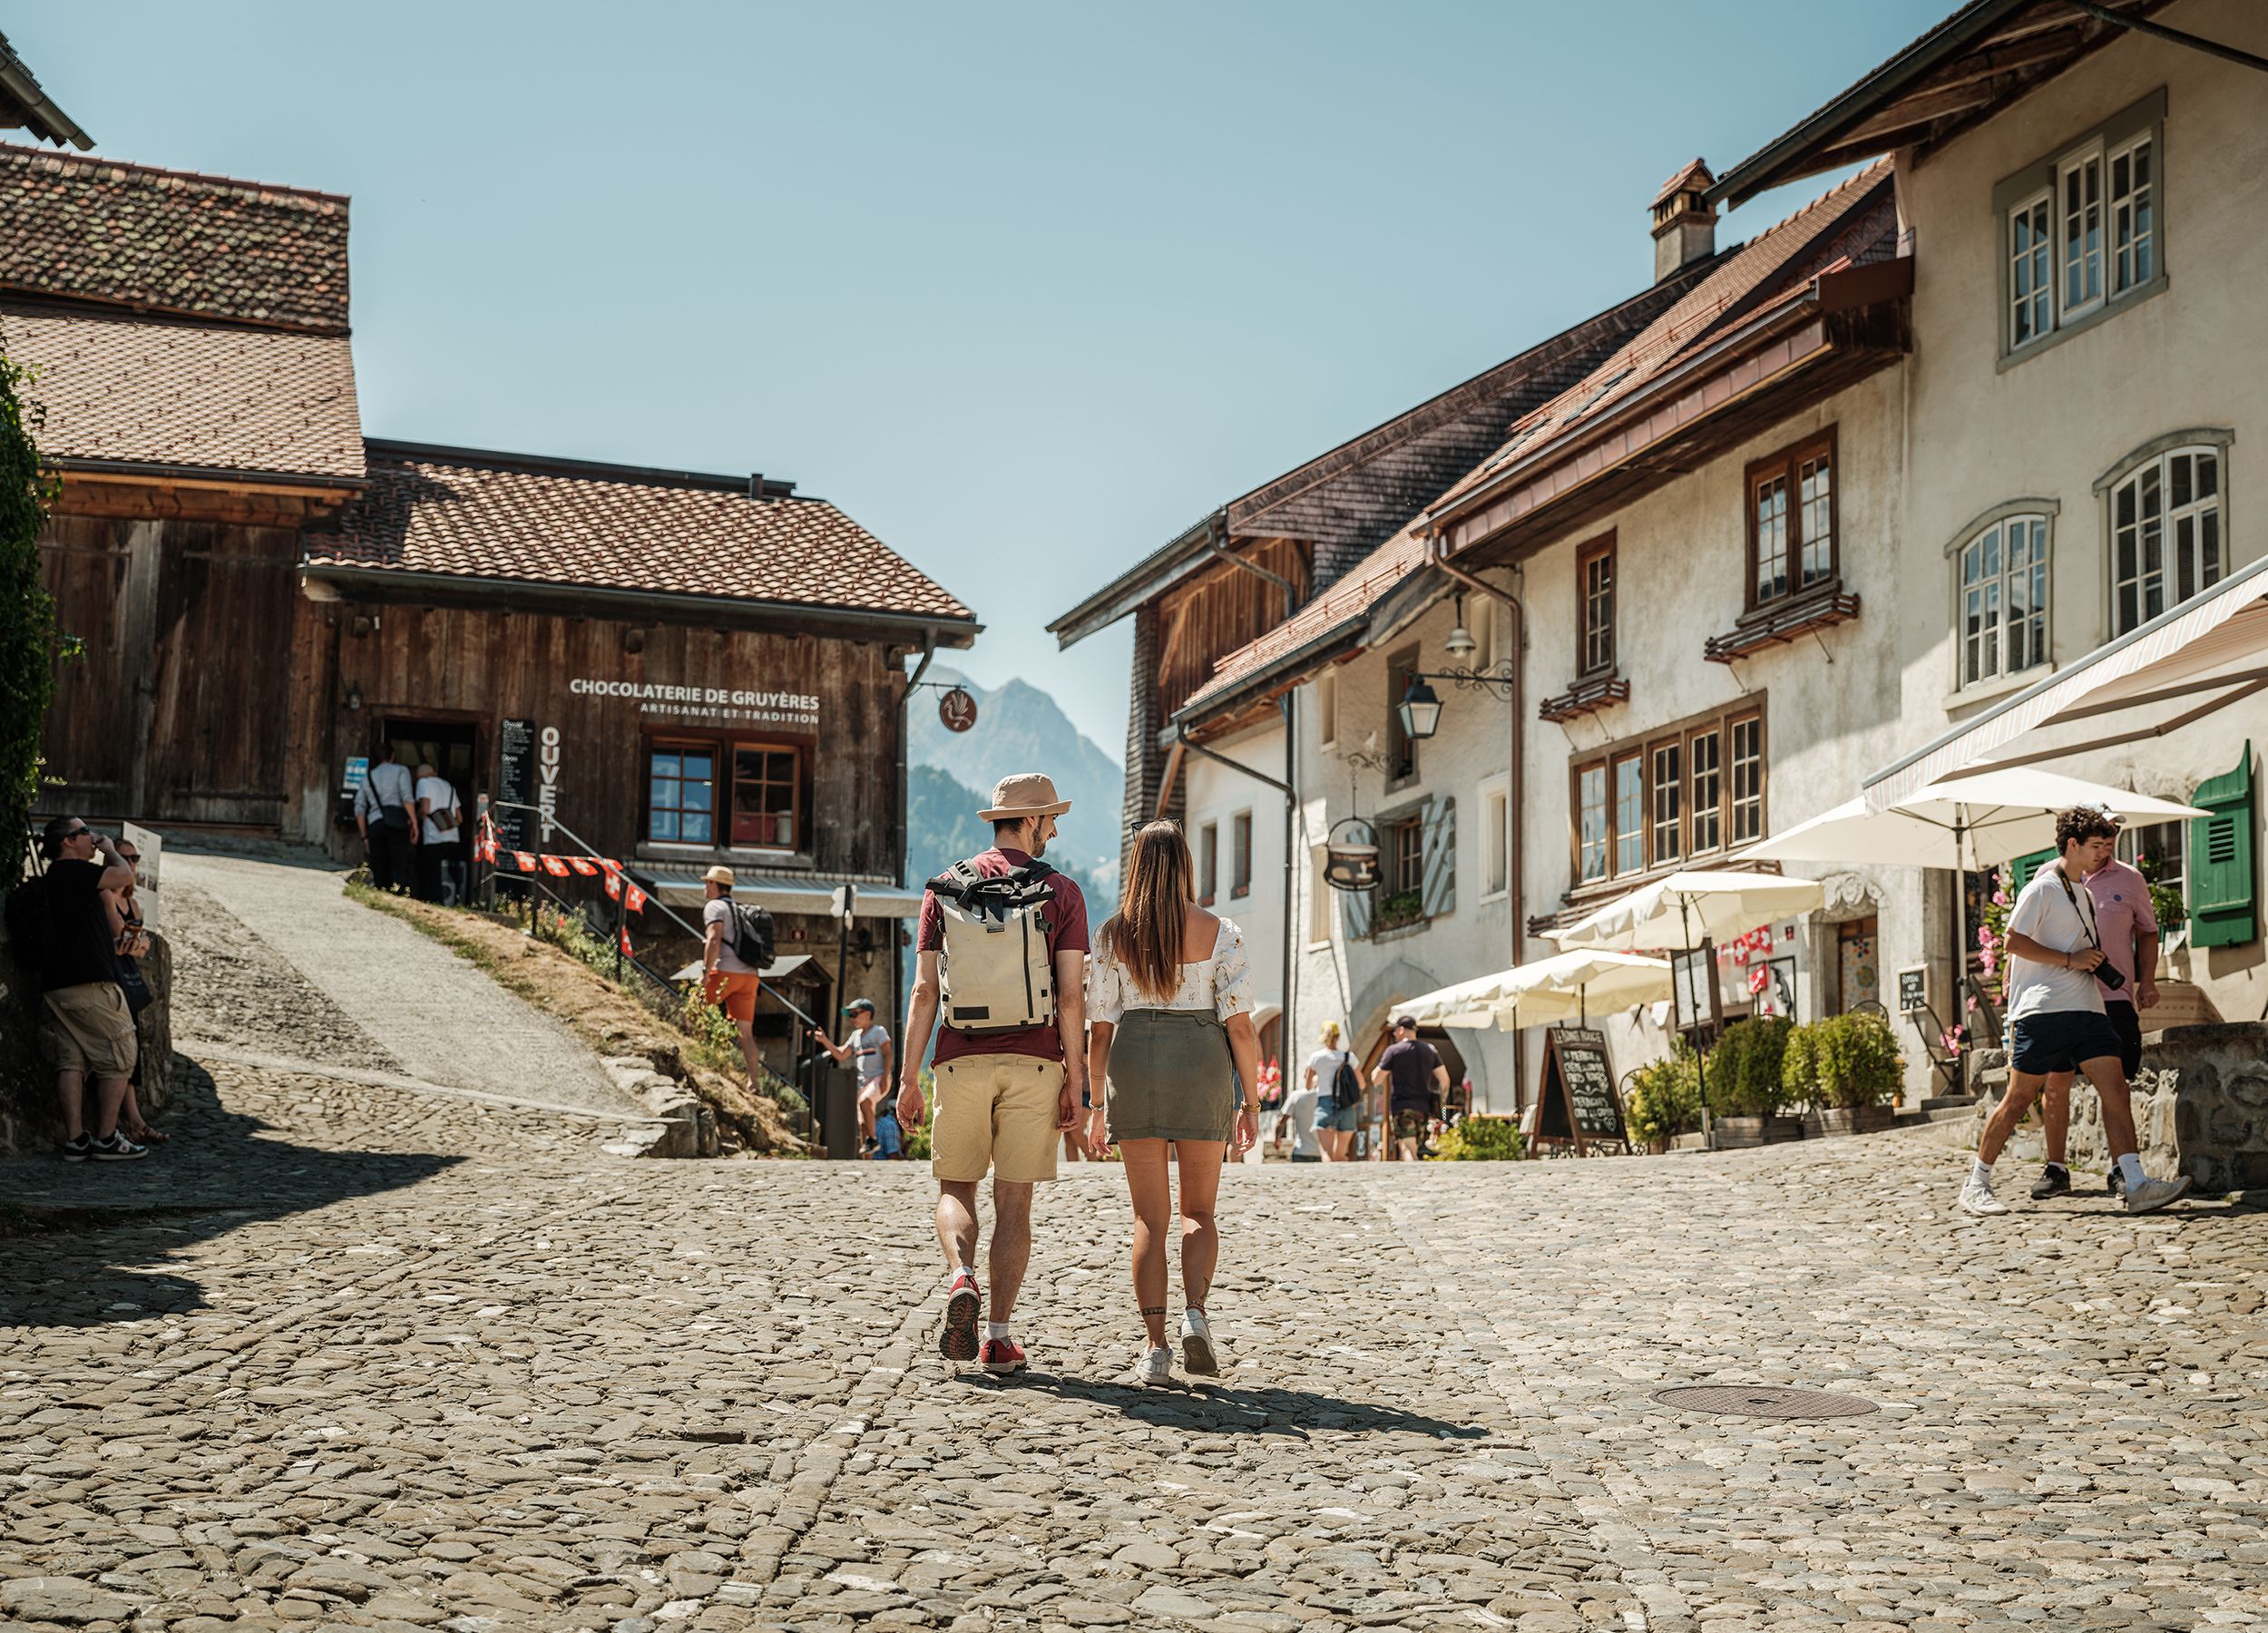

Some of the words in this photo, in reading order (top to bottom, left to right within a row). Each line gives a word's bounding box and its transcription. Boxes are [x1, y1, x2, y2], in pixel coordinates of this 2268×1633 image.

[569, 678, 702, 702] CHOCOLATERIE
[705, 688, 728, 704] DE
[731, 690, 820, 710] GRUYÈRES
[640, 702, 717, 717] ARTISANAT
[723, 709, 739, 719] ET
[745, 709, 819, 725] TRADITION
[539, 726, 561, 844] OUVERT
